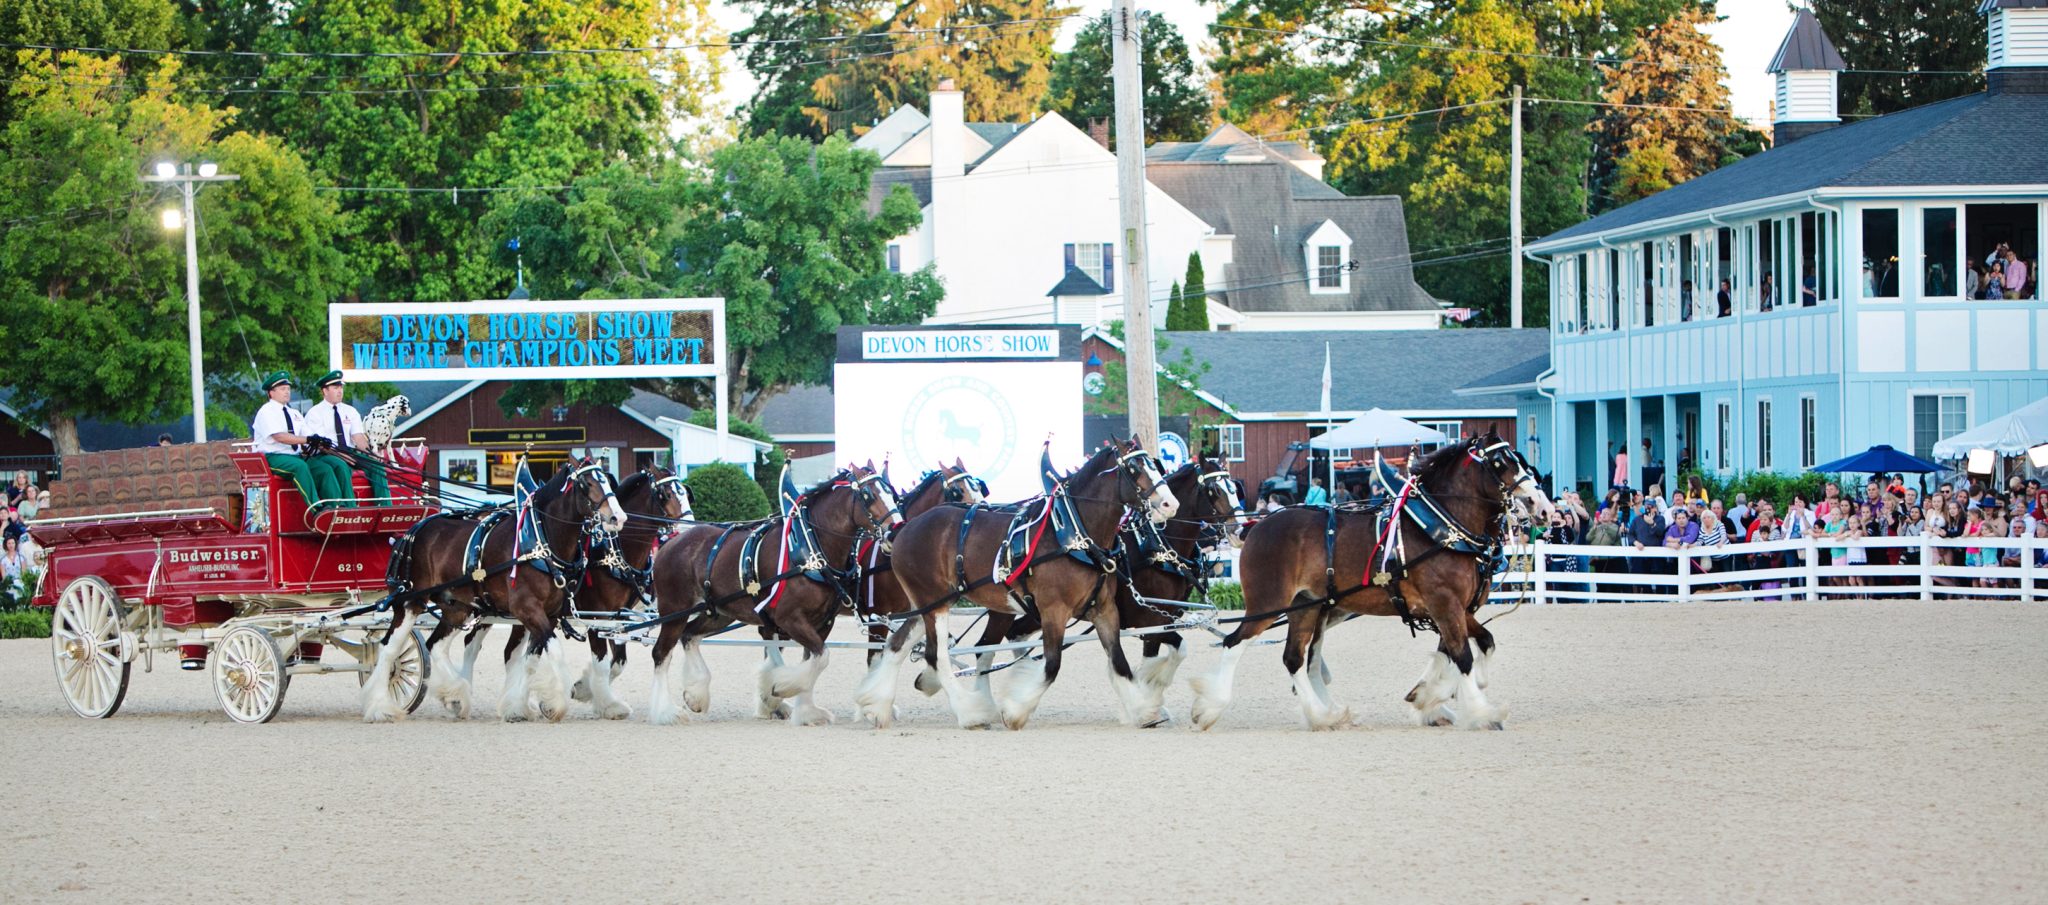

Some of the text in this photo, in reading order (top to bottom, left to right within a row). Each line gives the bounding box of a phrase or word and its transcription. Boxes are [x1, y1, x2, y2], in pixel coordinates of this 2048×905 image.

[381, 311, 673, 343] DEVON HORSE SHOW
[353, 338, 704, 369] WHERE CHAMPIONS MEET
[868, 336, 926, 354] DEVON
[1002, 335, 1051, 352] SHOW
